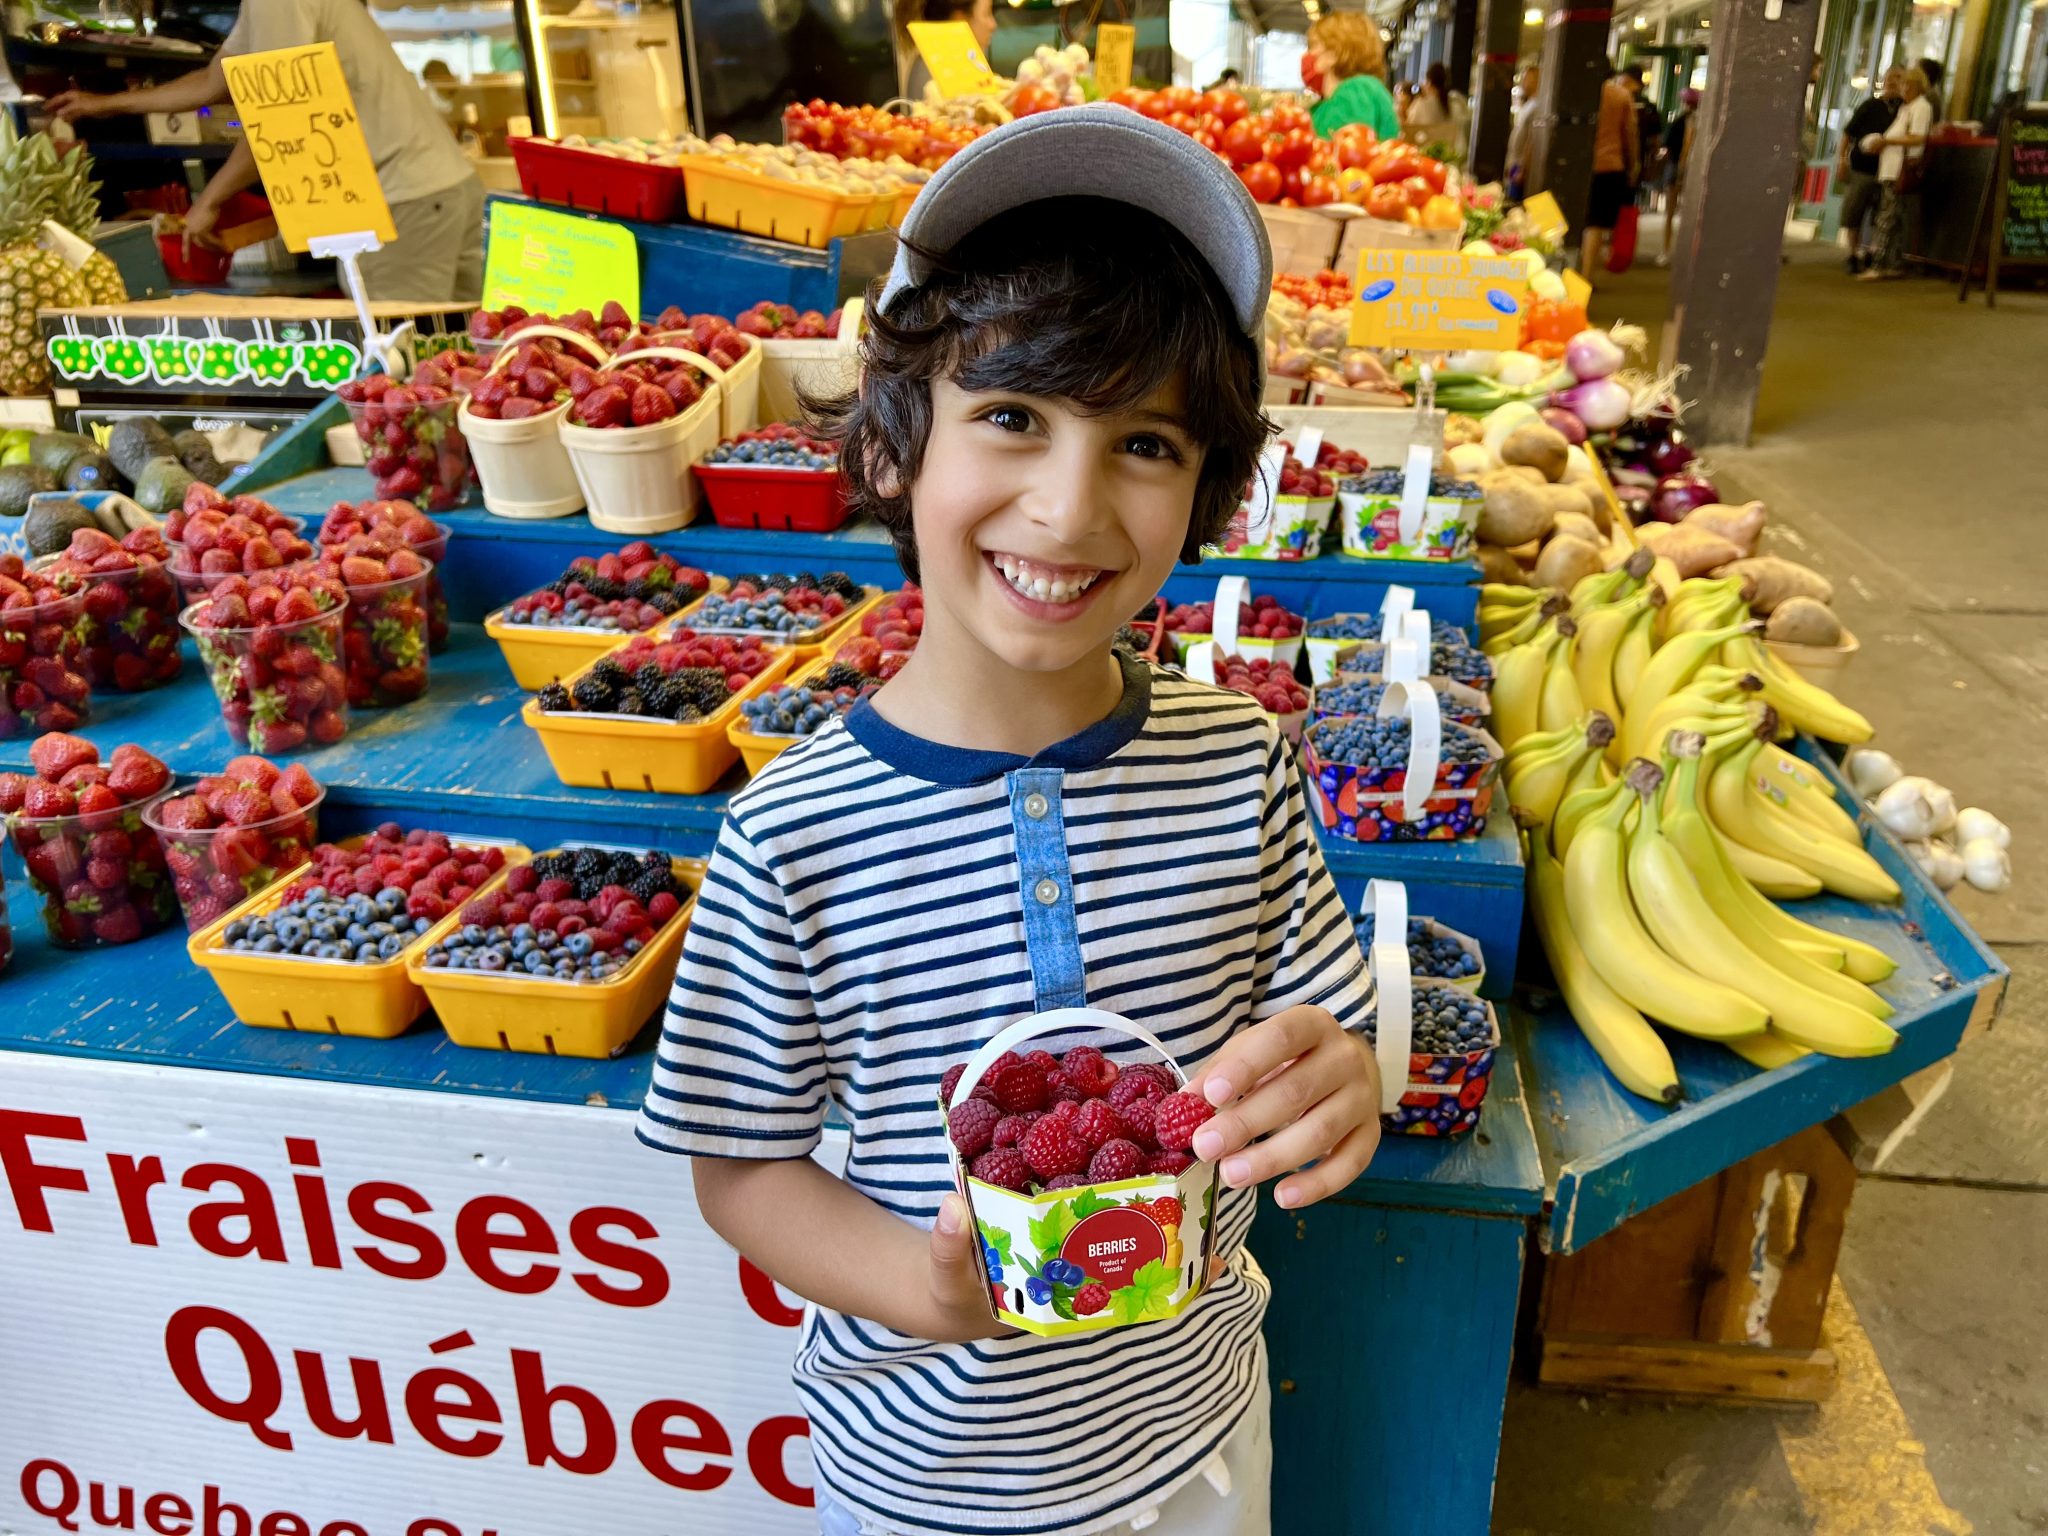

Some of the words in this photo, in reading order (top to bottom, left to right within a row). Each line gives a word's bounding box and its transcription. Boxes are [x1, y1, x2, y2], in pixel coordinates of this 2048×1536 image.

[248, 122, 275, 164] 3
[0, 1109, 670, 1308] Fraises
[1088, 1237, 1137, 1257] BERRIES
[1099, 1259, 1120, 1267] Product
[1103, 1265, 1122, 1273] Canada
[165, 1306, 816, 1508] Québec
